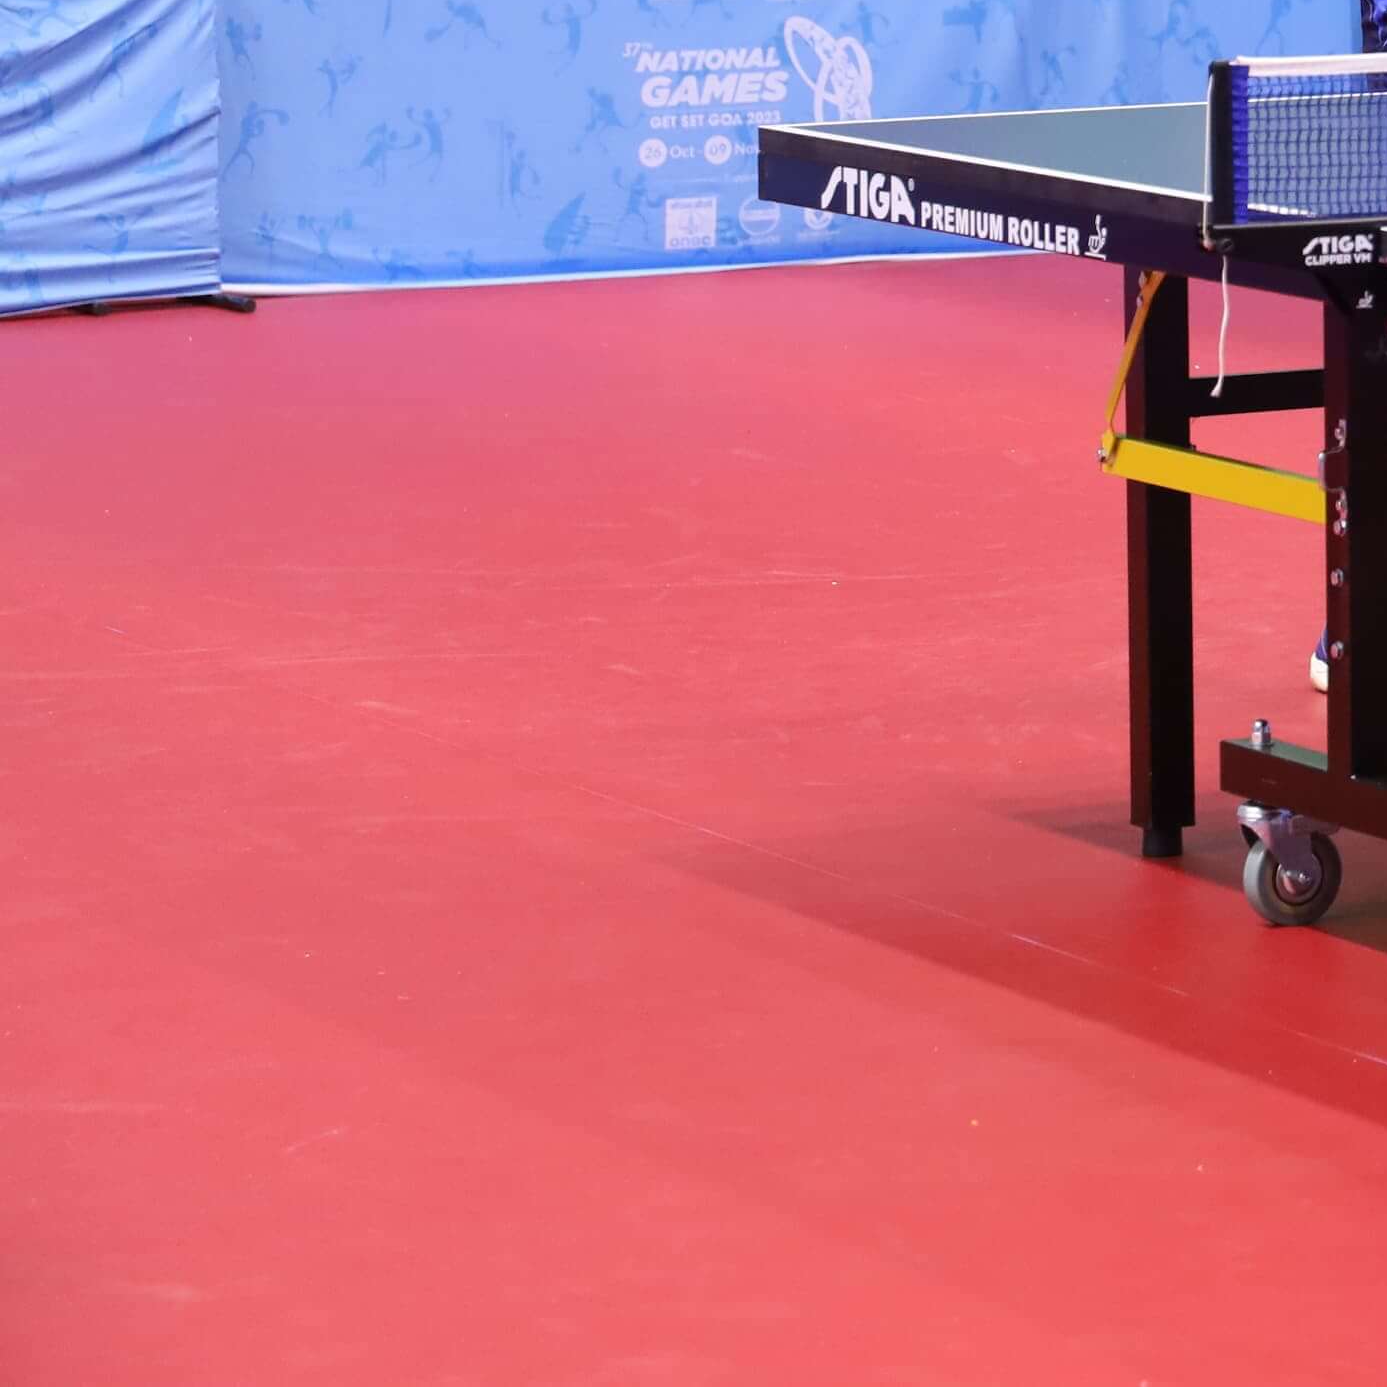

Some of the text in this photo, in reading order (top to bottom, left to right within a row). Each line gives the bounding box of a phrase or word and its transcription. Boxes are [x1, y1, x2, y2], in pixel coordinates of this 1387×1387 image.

[634, 46, 781, 73] NATIONAL
[641, 71, 790, 107] GAMES
[650, 110, 781, 129] GET SET GOA 2023
[670, 145, 695, 159] Oct
[921, 201, 1003, 242] PREMIUM
[1008, 216, 1081, 256] ROLLER
[1305, 252, 1372, 266] CLIPPER VM
